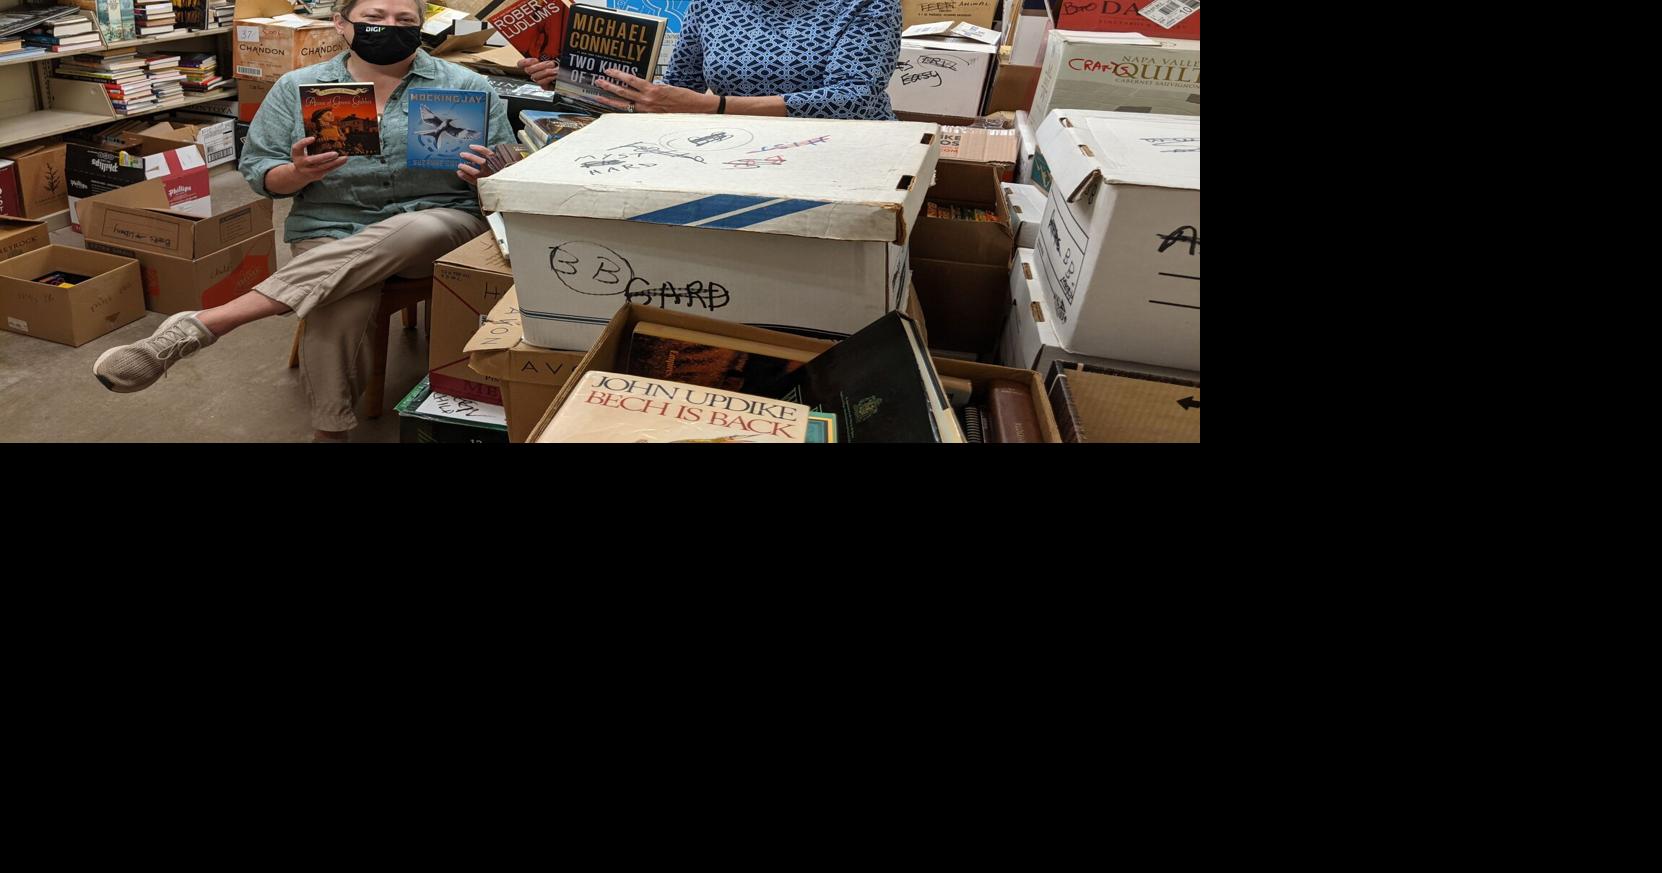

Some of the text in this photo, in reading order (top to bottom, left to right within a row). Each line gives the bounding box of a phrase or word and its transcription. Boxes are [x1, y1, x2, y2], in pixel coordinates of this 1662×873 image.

[494, 0, 549, 31] ROBER
[501, 2, 560, 39] LUDLUM'S
[573, 13, 648, 44] MICHAEL
[239, 43, 285, 56] CHANDON
[300, 43, 343, 57] CHANDON
[570, 31, 646, 62] CONNELLY
[569, 53, 596, 71] TWO
[1122, 55, 1156, 65] NAPA
[571, 69, 587, 83] OF
[410, 93, 482, 104] MOCKINGJAY
[168, 185, 192, 197] Phillips
[592, 376, 798, 422] JOHN UPDIKE
[585, 390, 796, 439] BECH IS BACK
